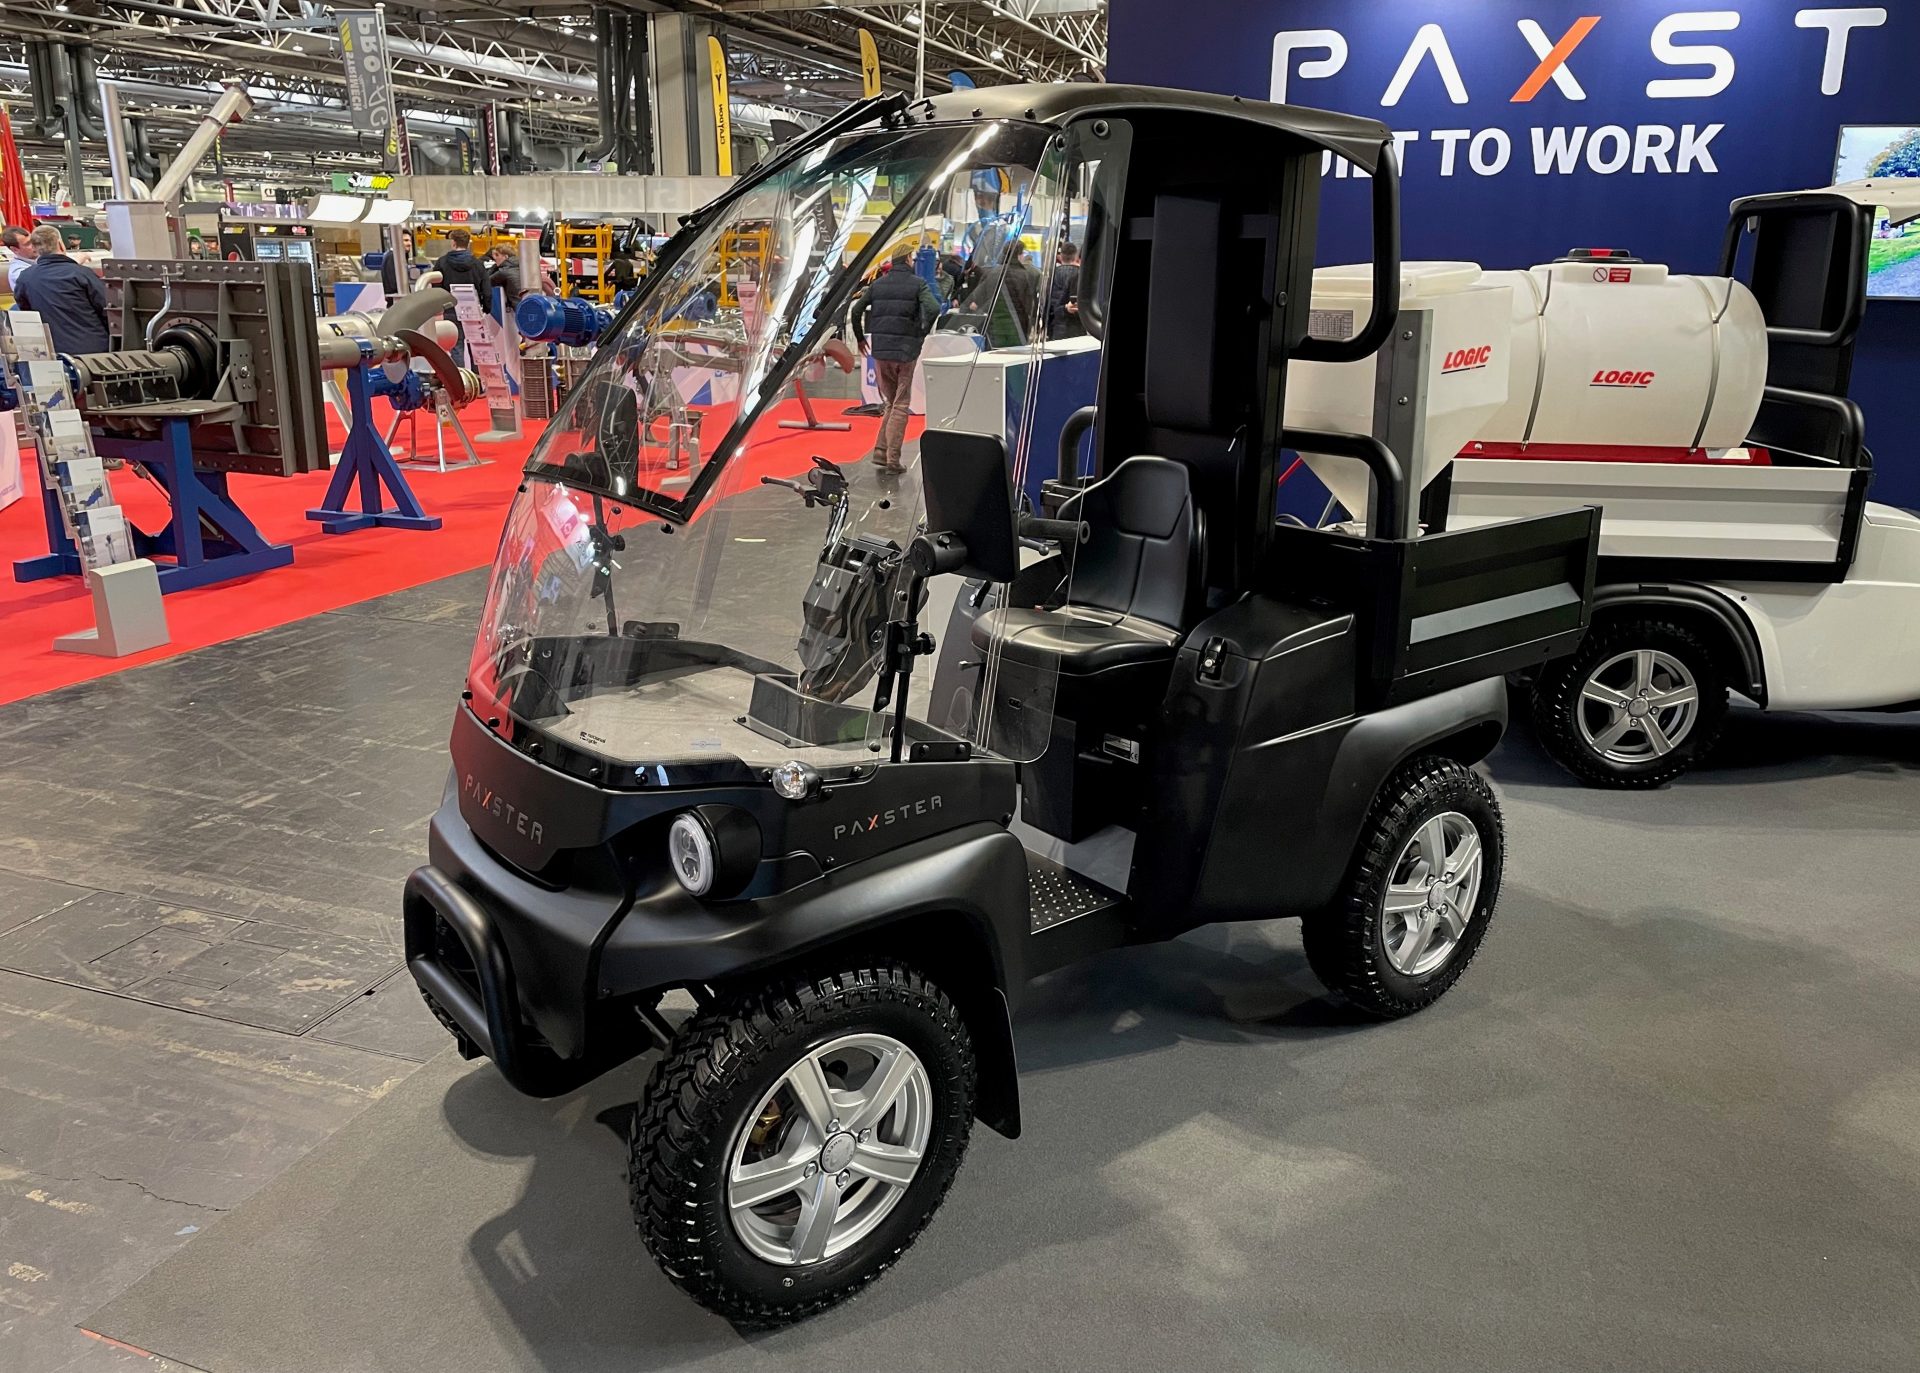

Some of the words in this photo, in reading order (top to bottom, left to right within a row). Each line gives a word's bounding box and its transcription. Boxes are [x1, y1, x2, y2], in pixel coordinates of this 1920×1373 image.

[1269, 7, 1887, 107] PAXST
[1430, 127, 1511, 177] TO
[1530, 123, 1725, 175] WORK
[1442, 345, 1492, 370] LOGIC
[1591, 370, 1655, 385] LOGIC
[465, 773, 543, 845] PAXSTER
[833, 795, 942, 840] PAXSTER
